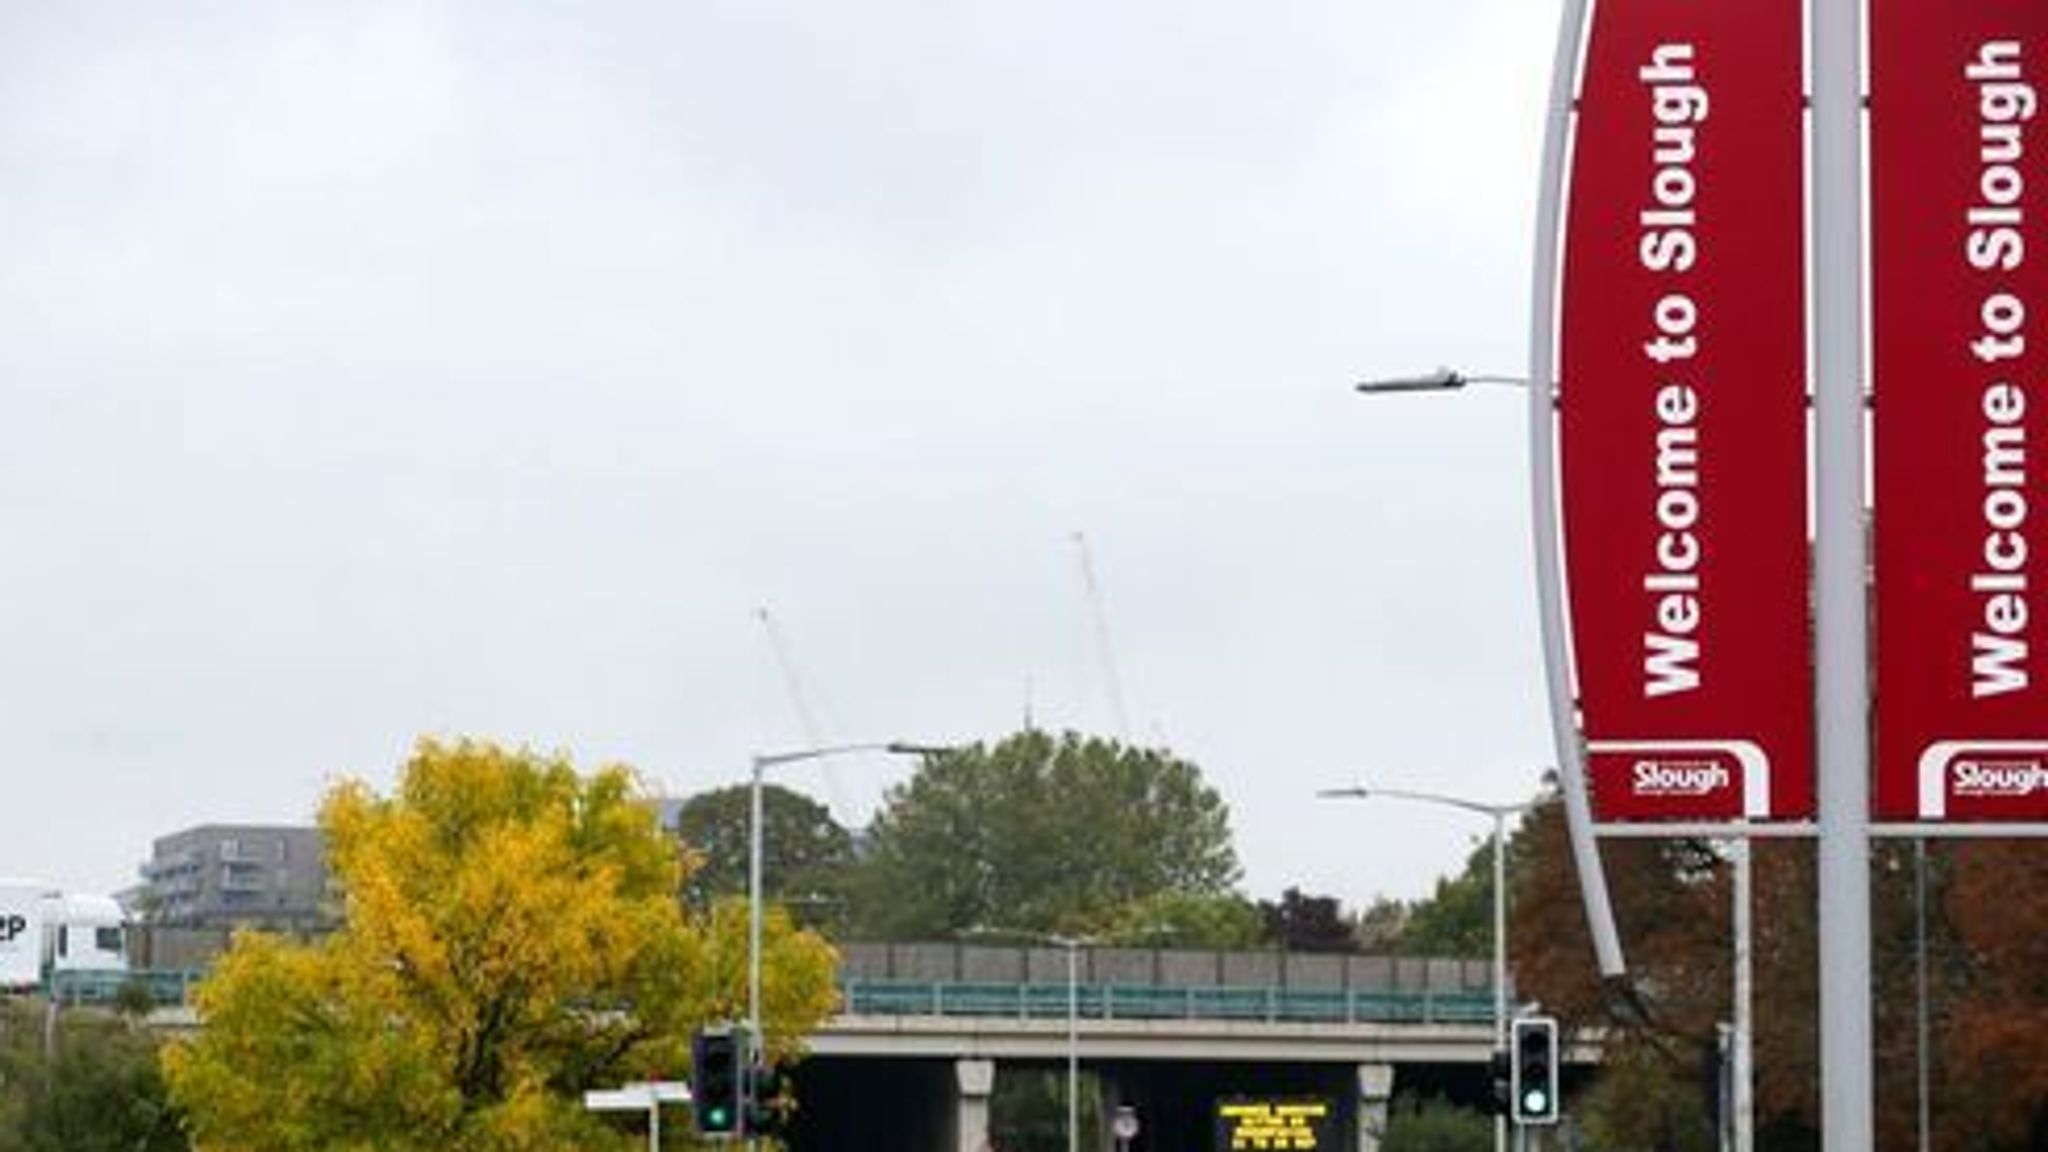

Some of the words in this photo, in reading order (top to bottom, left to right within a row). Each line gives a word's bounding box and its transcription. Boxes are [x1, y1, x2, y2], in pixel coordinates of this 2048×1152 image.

[1639, 44, 1709, 272] Slough
[1965, 41, 2037, 270] Slough
[1644, 295, 1697, 363] to
[1971, 293, 2025, 362] to
[1644, 385, 1700, 696] Welcome
[1972, 384, 2028, 697] Welcome
[1634, 761, 1729, 795] Slough
[1953, 761, 2048, 796] Slough
